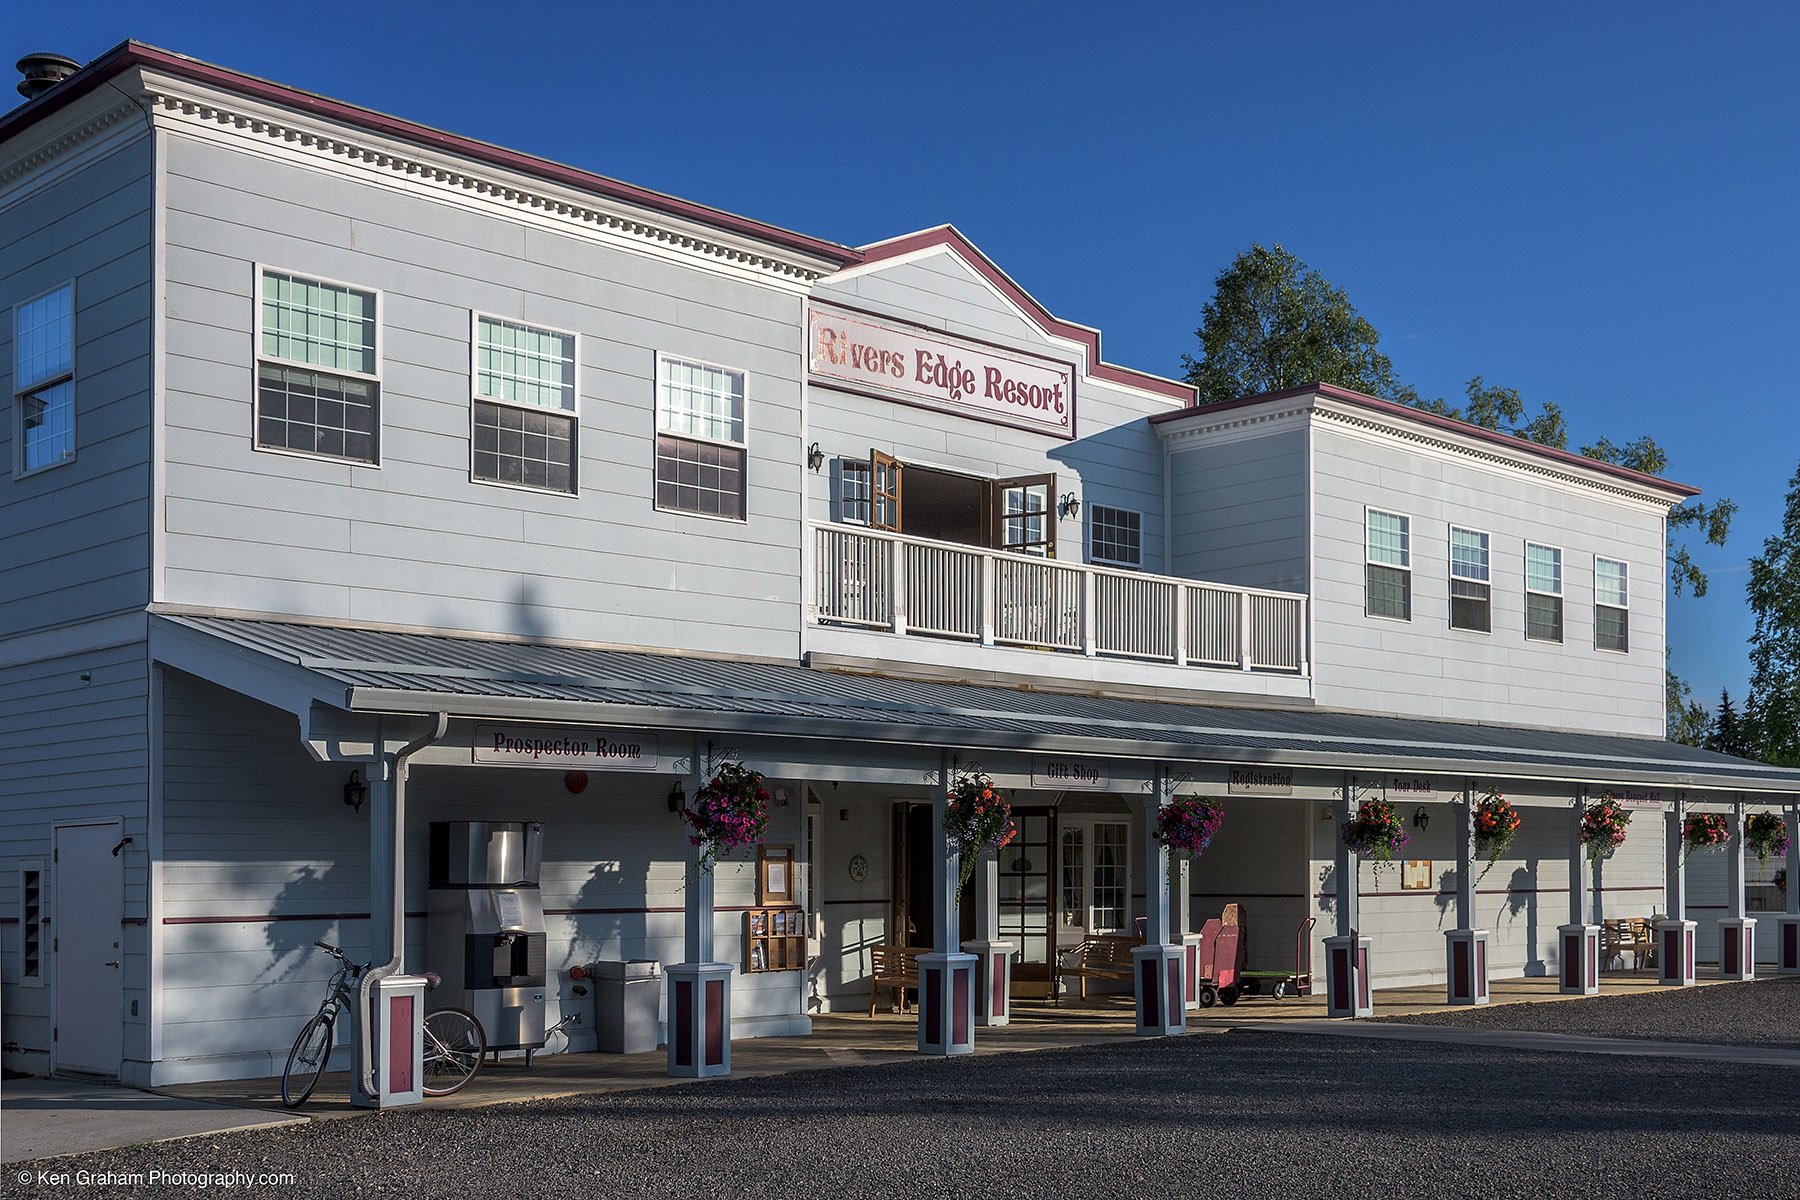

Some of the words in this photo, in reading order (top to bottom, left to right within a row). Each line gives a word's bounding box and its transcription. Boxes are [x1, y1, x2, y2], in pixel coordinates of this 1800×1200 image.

[817, 326, 905, 378] Rivers
[914, 348, 976, 401] Edge
[984, 365, 1064, 414] Resort
[493, 732, 589, 759] Prospector
[595, 737, 641, 759] Room
[1047, 762, 1069, 780] Gift
[1073, 763, 1099, 784] Shop
[1232, 770, 1291, 790] Registration
[1393, 778, 1410, 792] Tour
[1413, 779, 1431, 793] Desk
